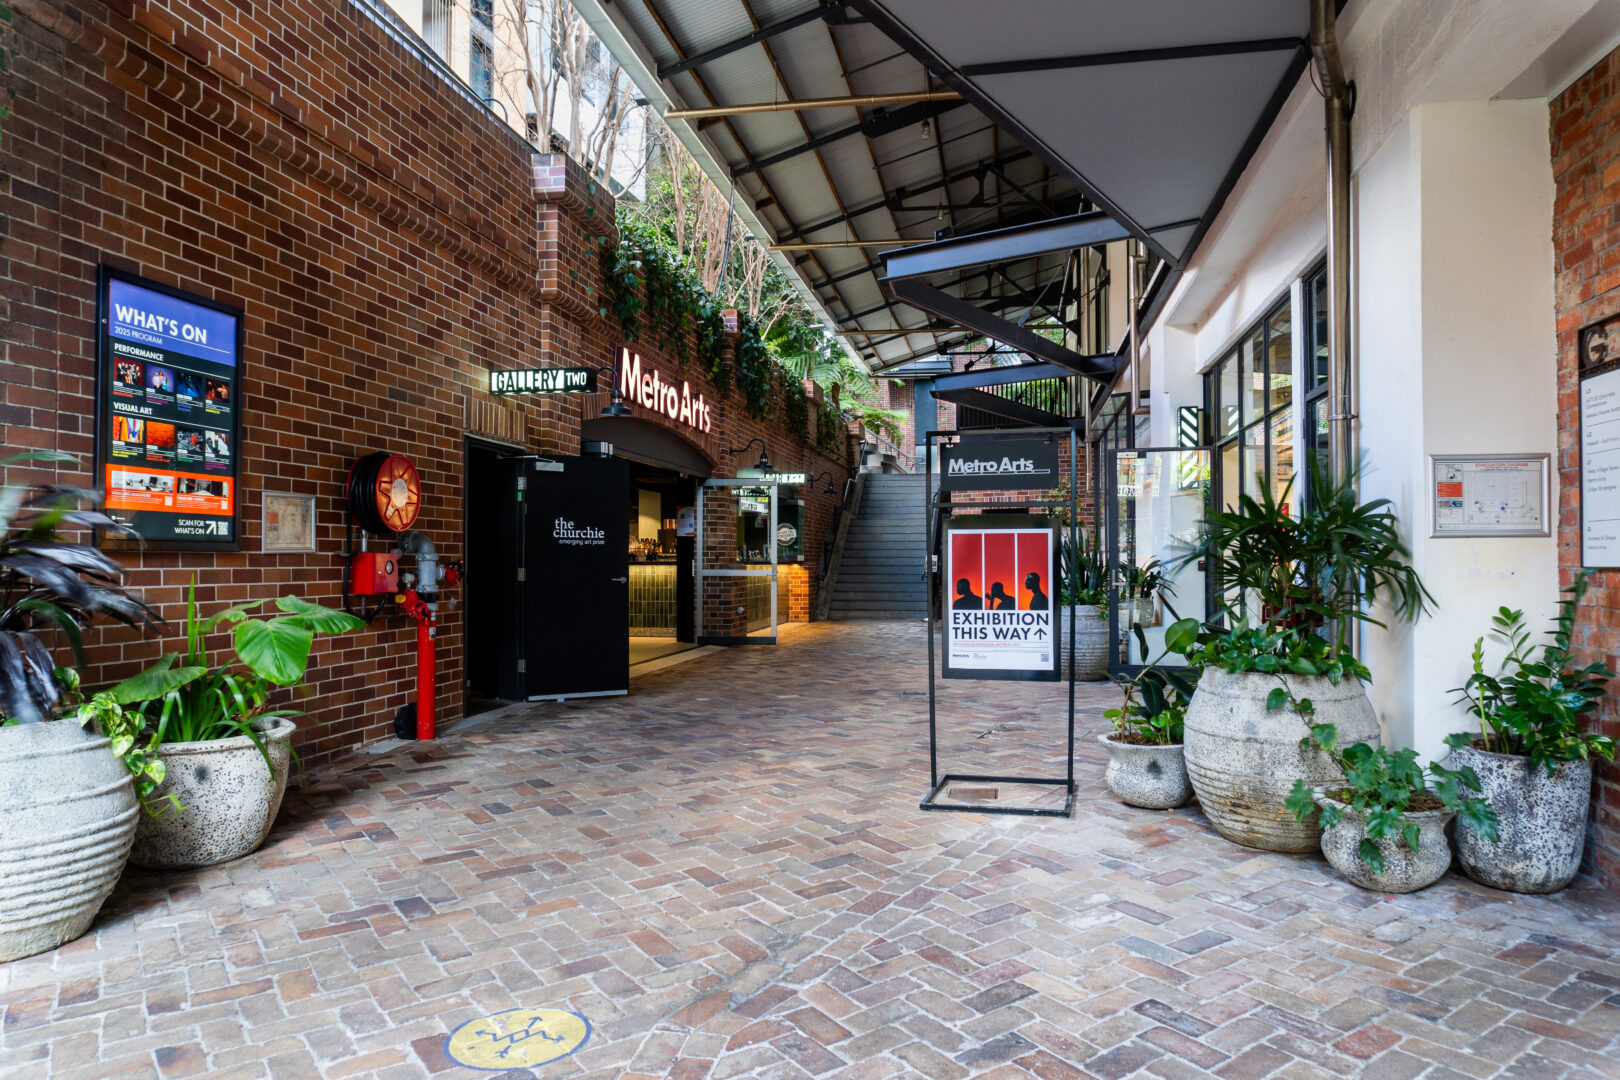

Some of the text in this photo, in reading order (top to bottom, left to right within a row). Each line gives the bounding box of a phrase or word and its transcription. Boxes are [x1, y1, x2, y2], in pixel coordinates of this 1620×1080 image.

[115, 303, 207, 344] WHAT'S ON
[114, 326, 163, 345] 2025 PROGRAM
[114, 342, 164, 361] PERFORMANCE
[496, 370, 588, 391] GALLERY TWO
[620, 347, 711, 434] Metro Arts
[113, 401, 153, 415] VISUAL ART
[948, 456, 1034, 474] Metro Arts
[174, 527, 196, 535] WHAT'S
[554, 517, 575, 529] the
[553, 526, 605, 539] churchie
[953, 612, 1049, 626] EXHIBITION
[952, 626, 1032, 641] THIS WAY
